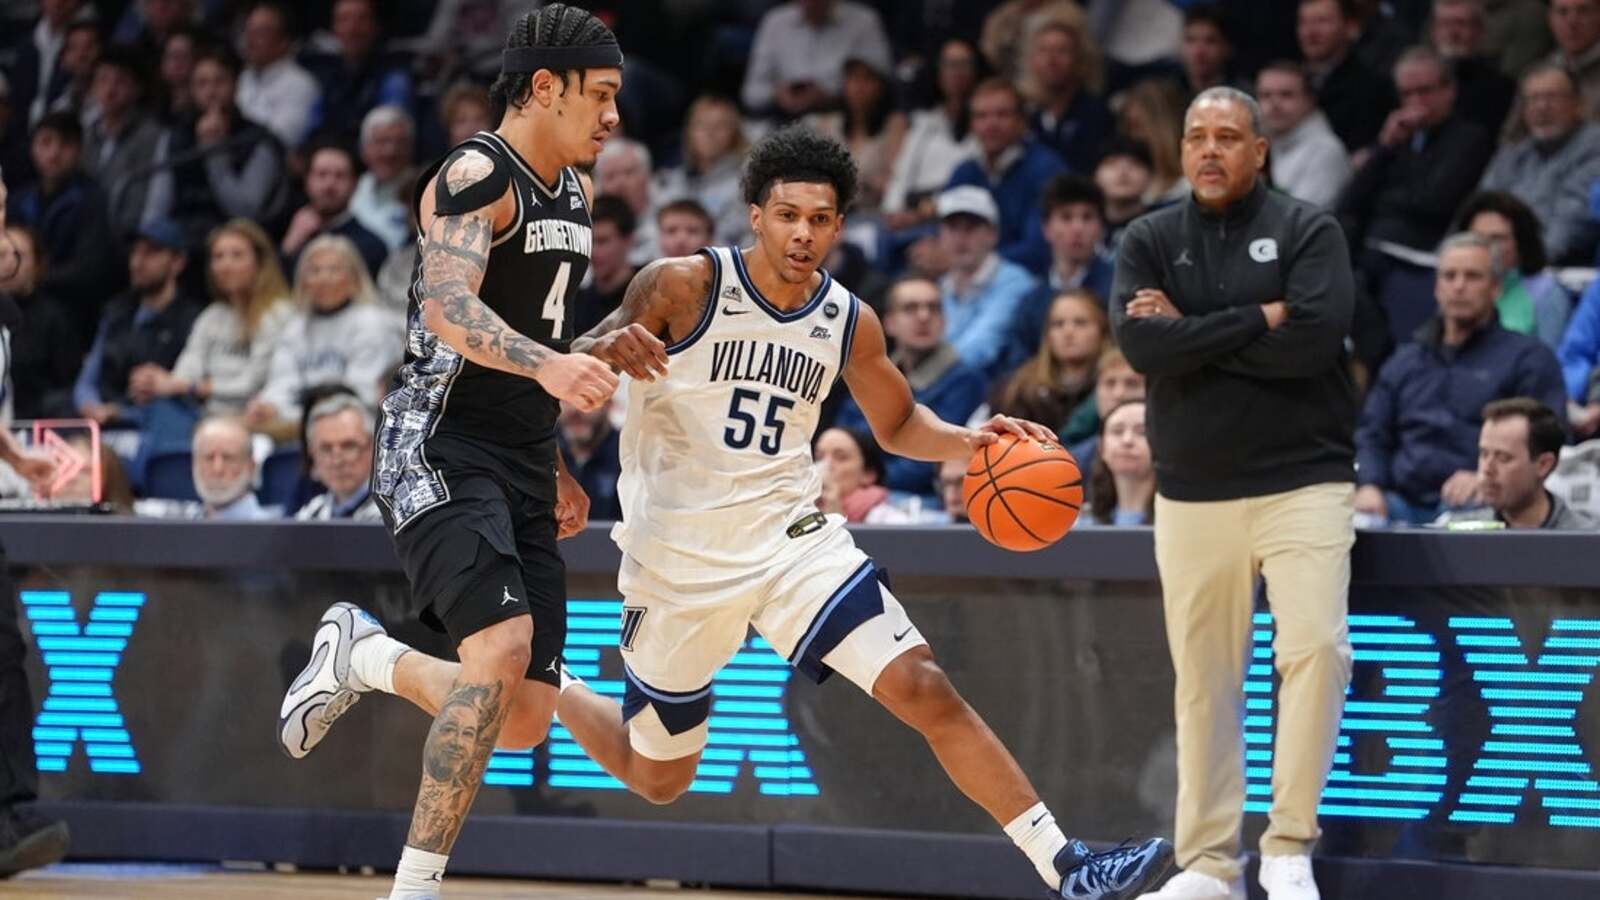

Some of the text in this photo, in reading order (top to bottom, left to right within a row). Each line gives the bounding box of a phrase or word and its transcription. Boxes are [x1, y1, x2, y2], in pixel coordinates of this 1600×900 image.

[541, 262, 571, 339] 4
[710, 340, 826, 404] VILLANOVA
[724, 387, 796, 456] 55
